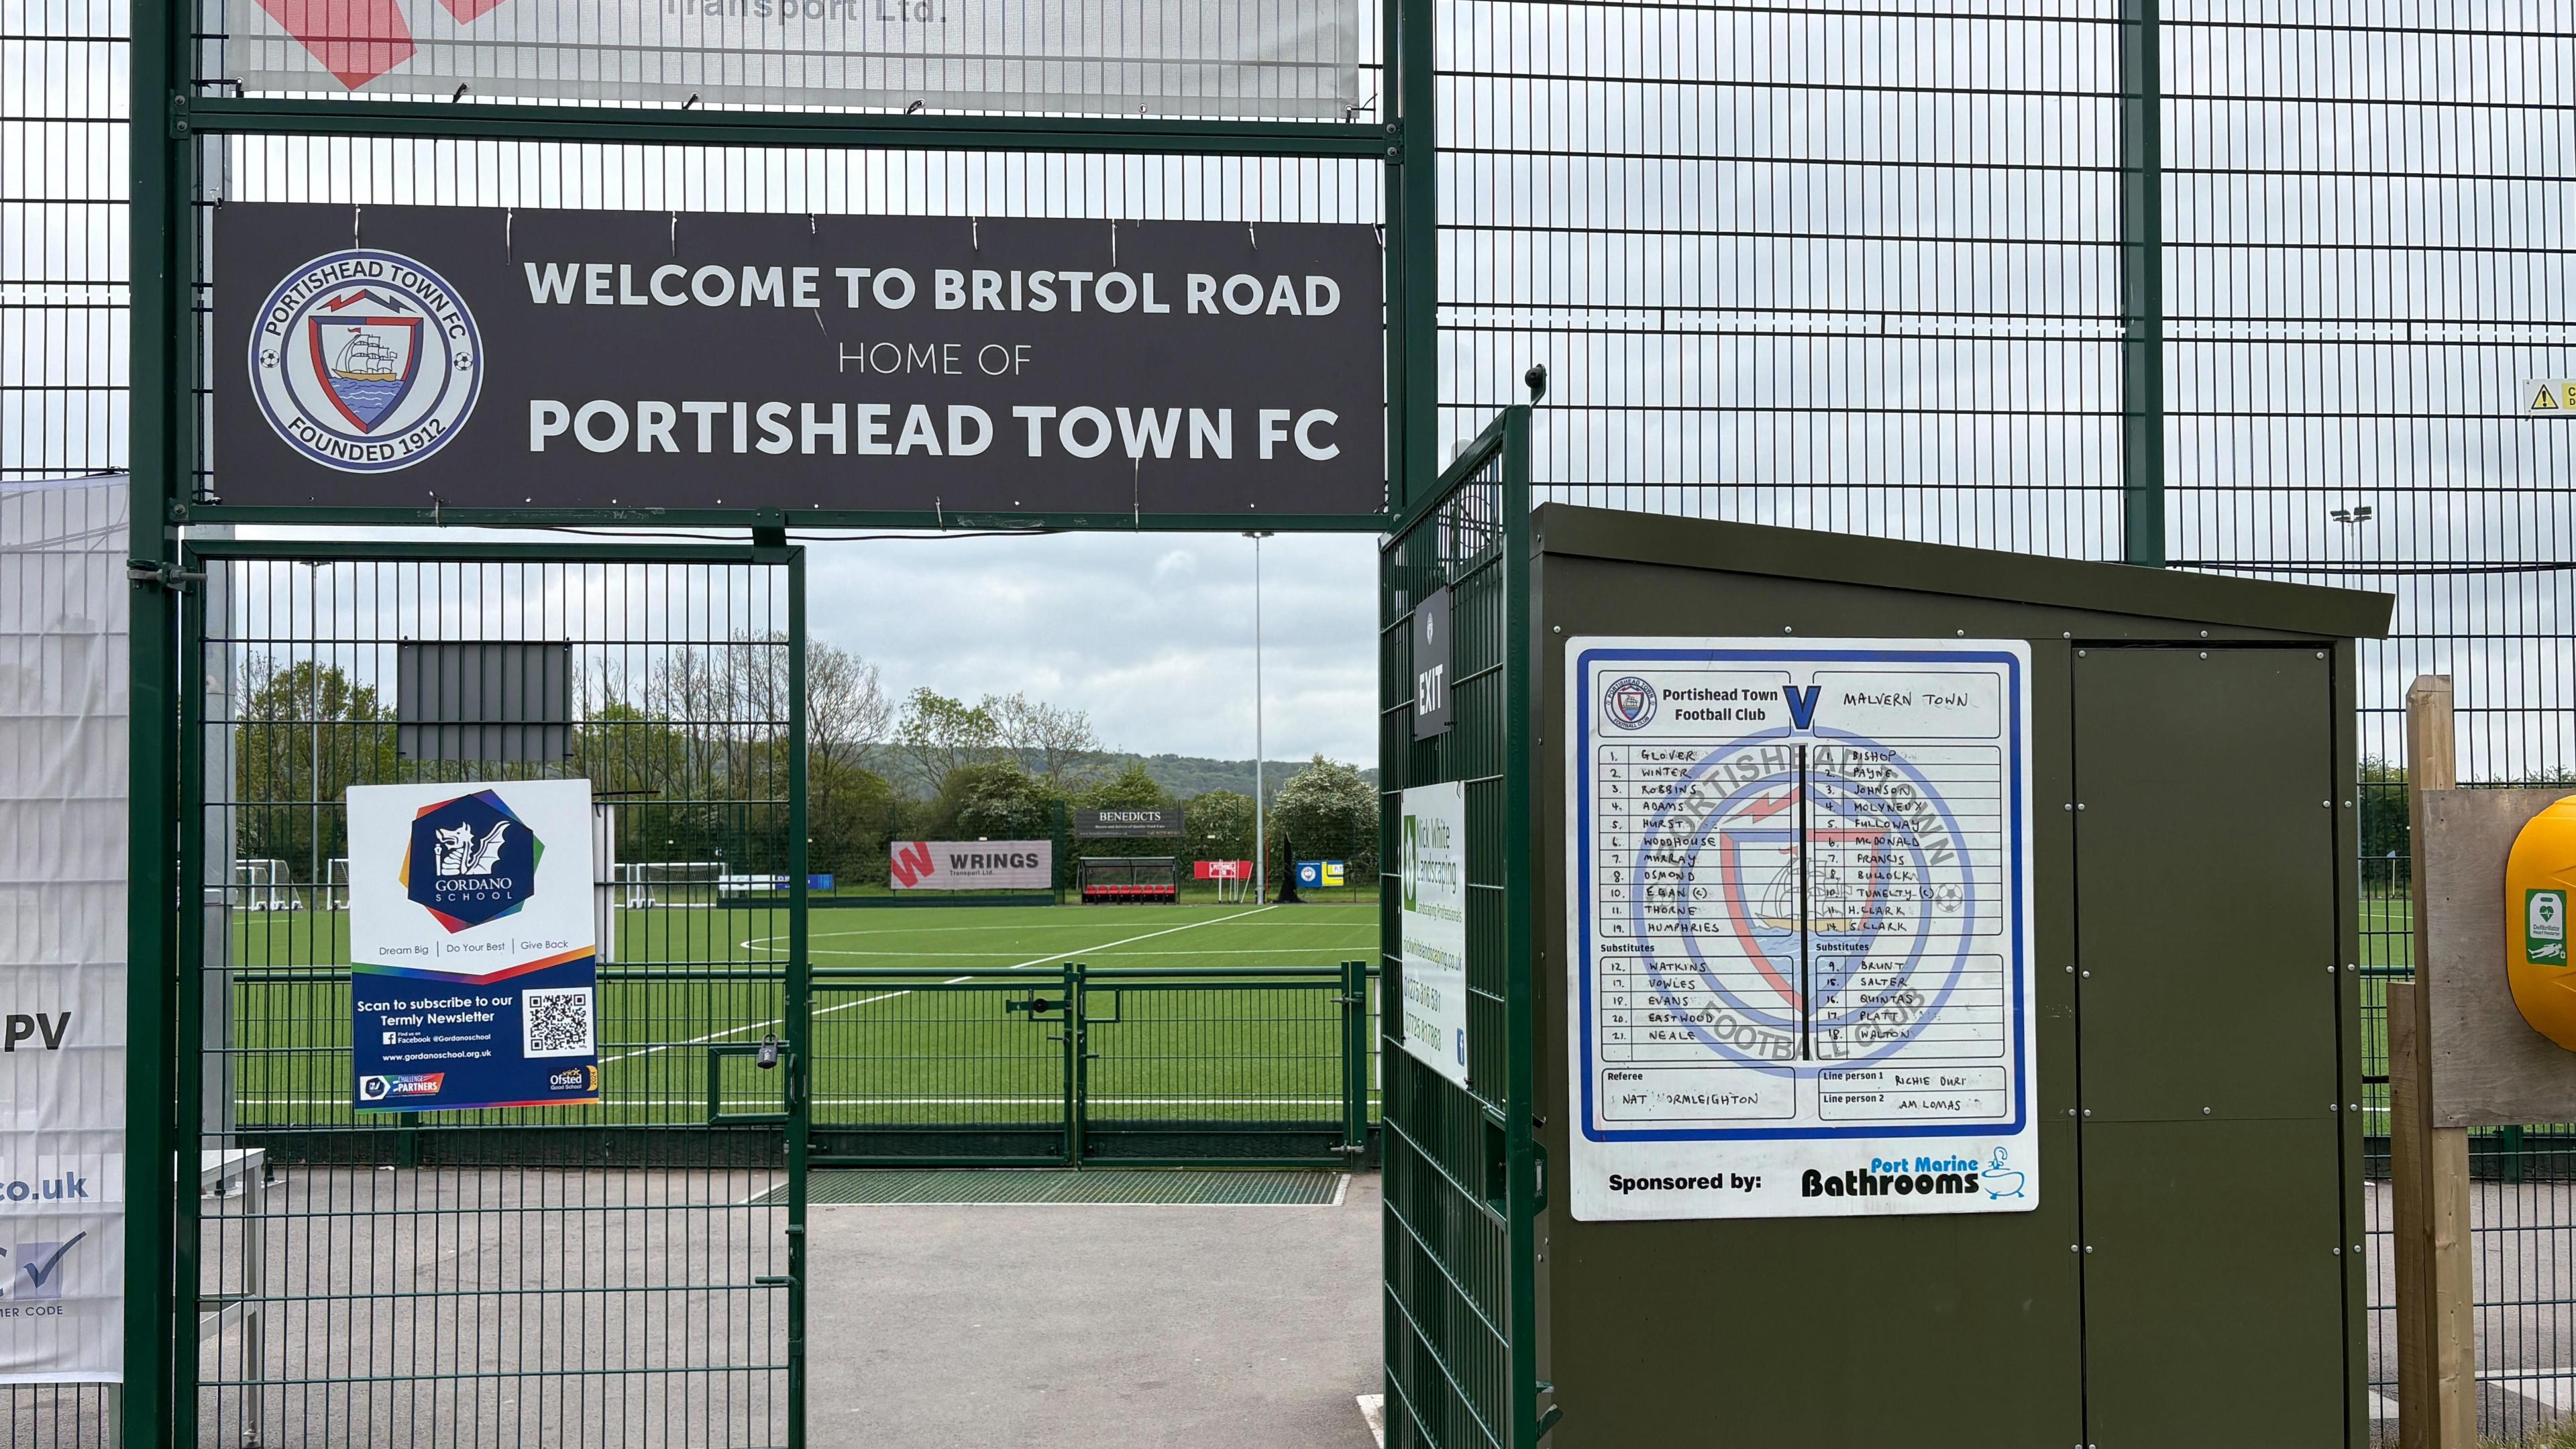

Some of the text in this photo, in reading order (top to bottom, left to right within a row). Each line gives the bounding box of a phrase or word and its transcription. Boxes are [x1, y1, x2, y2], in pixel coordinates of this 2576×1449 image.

[523, 262, 1340, 316] WELCOME TO BRISTOL ROAD
[265, 261, 466, 339] PORTISHEAD TOWN FC
[840, 342, 1031, 375] HOME OF
[530, 399, 1340, 461] PORTISHEAD TOWN FC
[288, 417, 446, 461] FOUNDED 1912
[1419, 663, 1443, 716] EXIT
[1608, 679, 1654, 698] PORTISHEAD TOWN
[1662, 688, 1778, 700] Portishead Town
[1843, 692, 1968, 706] MALVERN TOWN
[1782, 685, 1822, 730] V
[1675, 708, 1766, 720] Football Club
[1613, 716, 1650, 727] FOOTBALL CLUB
[1610, 749, 1697, 761] 1. GLOVER
[1853, 750, 1896, 762] BISHOP
[1610, 767, 1692, 778] 2. WINTER
[1854, 767, 1892, 779] PAYNE
[1612, 785, 1697, 795] 3. ROBBINS
[1827, 785, 1911, 795] 3. JOHNSON
[1644, 802, 1684, 812] ADAMS
[1854, 801, 1923, 812] MOLYNEUX
[1099, 812, 1161, 821] BENEDICTS
[1874, 769, 1955, 867] TOWN
[1610, 819, 1682, 829] 5. HURST
[1827, 820, 1837, 828] 5.
[1417, 818, 1450, 849] Nick White
[1644, 837, 1716, 847] WOODHOUSE
[950, 853, 1039, 869] WRINGS
[1611, 855, 1697, 867] 7. MURRAY
[1828, 854, 1904, 865] 7. FRANCIS
[1417, 853, 1456, 894] Landscaping
[1614, 871, 1695, 883] 8. OSMOND
[1829, 870, 1839, 880] 8.
[436, 878, 512, 891] GORDANO
[436, 892, 512, 902] SCHOOL
[1611, 889, 1625, 898] 10.
[1646, 886, 1686, 898] EGAN
[1417, 900, 1462, 924] Landscaping Professionals
[1644, 906, 1697, 915] THORNE
[1613, 923, 1719, 933] 19. HUMPHRIES
[379, 946, 429, 955] Dream Big
[447, 943, 505, 953] Do Your Best
[521, 940, 568, 950] Give Back
[1601, 944, 1655, 953] Substitutes
[1816, 943, 1869, 951] Substitutes
[1403, 936, 1462, 971] nickwhitelandscaping.co.uk
[1611, 963, 1706, 972] 12. WATKINS
[1829, 961, 1904, 972] 9. BRUNT
[1648, 979, 1695, 989] VOWLES
[1860, 978, 1907, 987] SALTER
[1405, 977, 1441, 1013] 01275 316 531
[1648, 996, 1688, 1005] EVANS
[1827, 994, 1913, 1004] 16. QUINTAS
[358, 996, 513, 1012] Scan to subscribe to our
[381, 1012, 495, 1027] Termly Newsletter
[1612, 1014, 1627, 1023] 20.
[1827, 1012, 1898, 1021] 17. PLATT
[4, 1012, 71, 1052] PV
[1405, 1011, 1441, 1052] 07725 817863
[1611, 1030, 1696, 1040] 21. NEALE
[1829, 1028, 1911, 1040] 18. WALTON
[433, 1034, 491, 1042] @Gordanoschool
[382, 1050, 492, 1061] www.gordanoschool.org.uk
[551, 1074, 582, 1085] Ofsted
[1607, 1072, 1643, 1081] Referee
[1823, 1072, 1842, 1080] Line
[1845, 1073, 1876, 1082] person
[1895, 1075, 1930, 1085] RICHIE
[398, 1082, 437, 1092] PARTNERS
[1623, 1094, 1647, 1104] NAT
[1823, 1094, 1884, 1105] Line person 2
[1923, 1100, 1961, 1111] LOMAS
[1871, 1157, 1978, 1173] Port Marine
[0, 1172, 89, 1201] o.uk
[1609, 1173, 1761, 1195] Sponsored by:
[1802, 1169, 1980, 1197] Bathrooms
[25, 1305, 63, 1316] CODE
